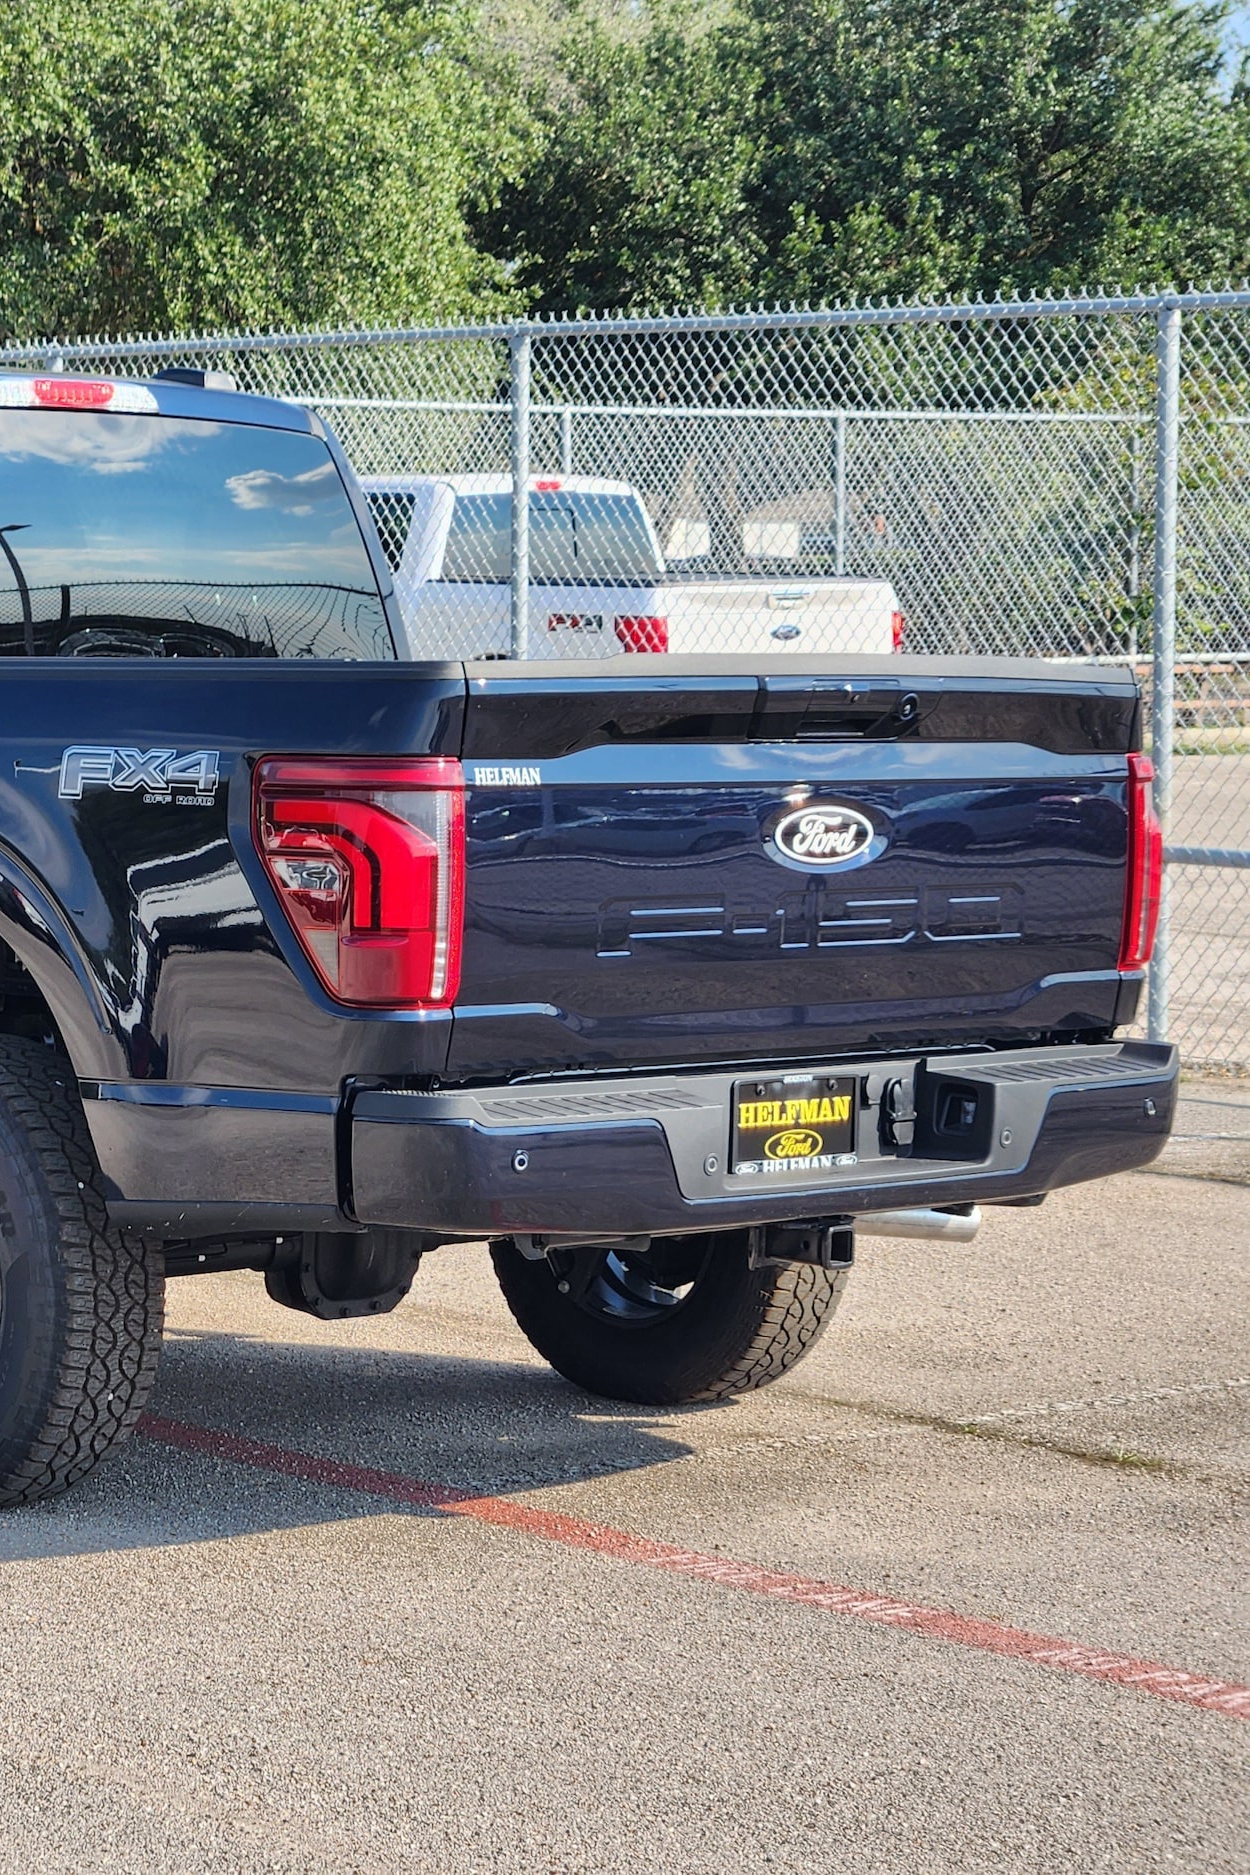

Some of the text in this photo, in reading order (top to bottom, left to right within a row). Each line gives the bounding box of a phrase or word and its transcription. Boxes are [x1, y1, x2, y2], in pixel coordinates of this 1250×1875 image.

[58, 745, 220, 799] FX4
[473, 767, 542, 786] HELFMAN
[142, 794, 215, 806] OFF ROAD
[792, 814, 858, 854] Ford
[596, 881, 1024, 957] F-150
[738, 1096, 852, 1128] HELFMAN
[776, 1133, 813, 1157] Ford
